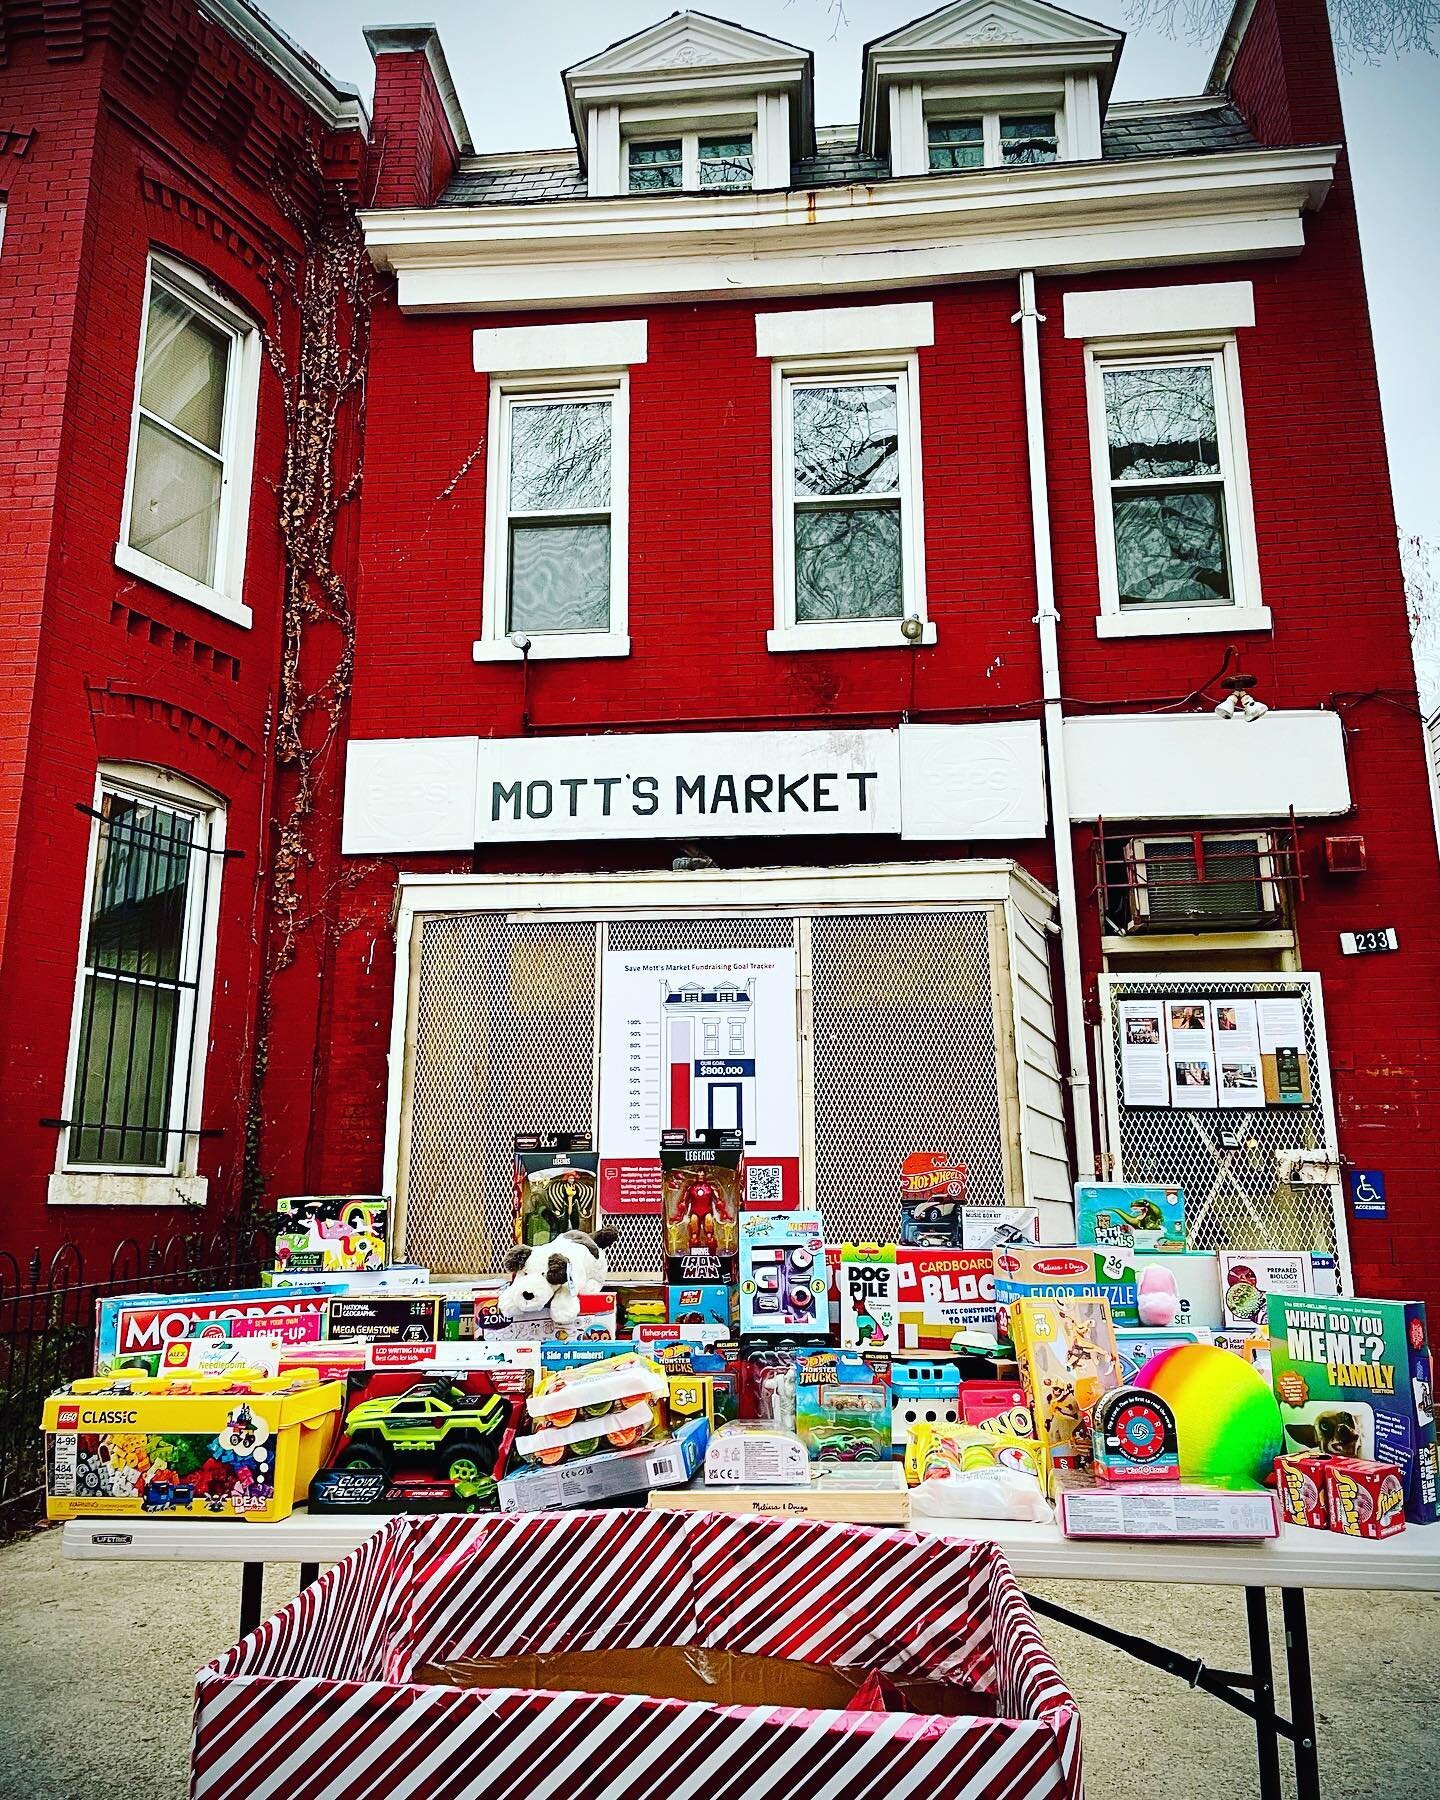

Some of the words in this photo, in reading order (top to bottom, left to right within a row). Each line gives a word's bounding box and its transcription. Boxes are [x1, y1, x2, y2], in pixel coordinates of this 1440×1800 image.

[491, 773, 659, 821] MOTT'S
[676, 772, 878, 815] MARKET
[1356, 931, 1387, 951] 233
[691, 963, 731, 971] Fundraising
[700, 1066, 743, 1076] $800,000
[685, 1151, 715, 1161] LEGENDS
[681, 1256, 721, 1267] IRON
[919, 1258, 993, 1273] CARDBOARD
[1108, 1256, 1122, 1269] 36
[683, 1266, 719, 1278] MAN
[848, 1267, 890, 1282] DOG
[815, 1282, 820, 1291] S
[849, 1282, 888, 1298] PILE
[921, 1274, 995, 1302] BLOC
[1083, 1286, 1134, 1305] PUZZLE
[410, 1307, 432, 1315] STEM
[959, 1306, 997, 1314] CONSTRUCT
[285, 1317, 299, 1325] OWN
[949, 1317, 960, 1325] TO
[962, 1315, 979, 1323] NEW
[1175, 1315, 1191, 1324] SET
[1285, 1310, 1327, 1330] WHAT
[1329, 1314, 1350, 1334] DO
[1353, 1316, 1383, 1335] YOU
[246, 1327, 306, 1340] LIGHT-UP
[333, 1325, 356, 1334] MEGA
[356, 1326, 399, 1334] GEMSTONE
[642, 1329, 678, 1337] fisher-price
[1287, 1328, 1385, 1365] MEME?
[547, 1351, 561, 1359] Side
[563, 1351, 570, 1359] of
[572, 1351, 604, 1359] Numbers!
[199, 1361, 246, 1369] Needlepoint
[665, 1364, 692, 1372] UCKS
[800, 1372, 838, 1384] TRUCKS
[1327, 1362, 1394, 1390] FAMILY
[60, 1412, 77, 1421] LEGO
[82, 1411, 137, 1424] CLASSIC
[978, 1406, 1034, 1439] UNO
[57, 1437, 76, 1445] 4-99
[1424, 1447, 1436, 1503] MEME?
[338, 1476, 377, 1486] GLOW
[323, 1486, 378, 1497] Racers
[232, 1496, 266, 1507] IDEAS
[1333, 1468, 1361, 1536] Slinky
[1376, 1489, 1403, 1521] Slinky
[752, 1503, 780, 1511] Melissa
[787, 1503, 808, 1513] Doug
